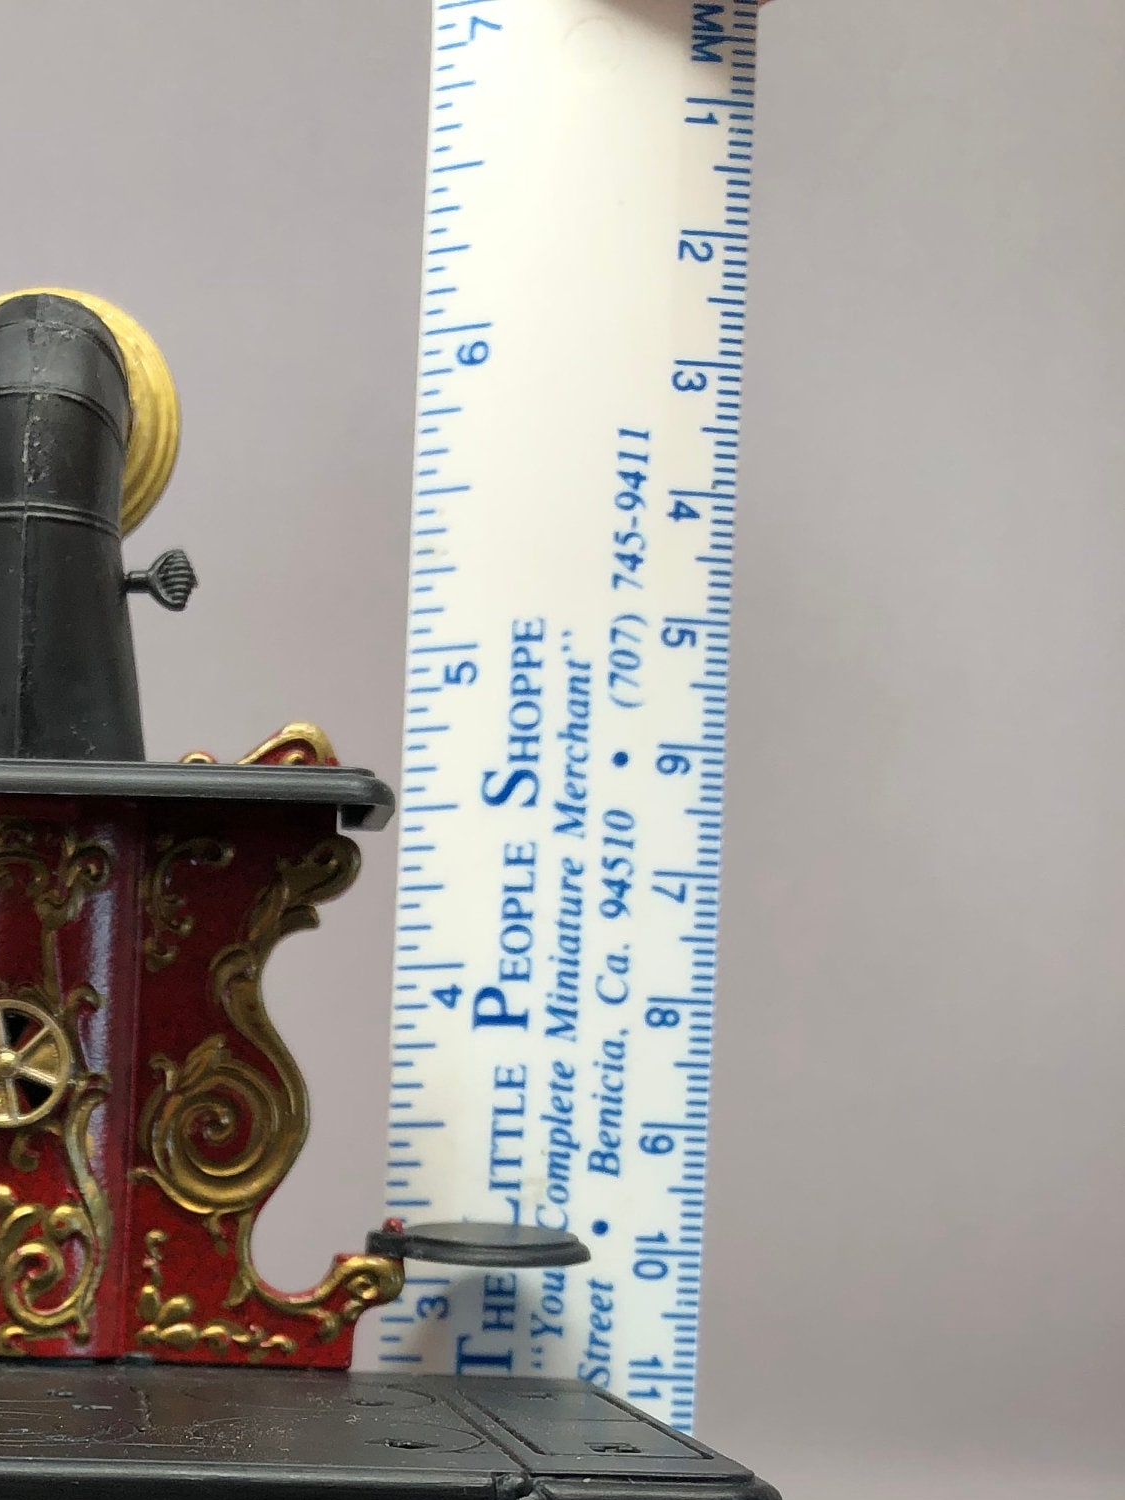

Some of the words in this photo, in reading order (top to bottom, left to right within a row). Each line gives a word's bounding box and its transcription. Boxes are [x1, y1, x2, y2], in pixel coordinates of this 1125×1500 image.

[468, 15, 503, 41] 7
[690, 3, 724, 63] MM
[683, 112, 719, 125] 1
[678, 240, 715, 263] 2
[455, 339, 491, 367] 6
[671, 369, 708, 393] 3
[611, 427, 652, 590] 745-9411
[667, 499, 701, 522] 4
[607, 612, 650, 709] (707)
[660, 626, 698, 650] 5
[443, 660, 479, 686] 5
[480, 615, 545, 810] SHOPPE
[655, 754, 693, 777] 6
[598, 807, 637, 920] 94510
[651, 881, 688, 904] 7
[470, 840, 538, 1031] PEOPLE
[542, 855, 587, 1041] Miniature
[430, 983, 465, 1010] 4
[594, 942, 632, 1007] Ca.
[644, 1007, 682, 1031] 8
[586, 1028, 631, 1178] Benicia,
[535, 1058, 582, 1232] Complete
[638, 1131, 677, 1157] 9
[632, 1231, 669, 1281] 10
[416, 1295, 449, 1320] 3
[455, 1271, 517, 1377] THE
[529, 1265, 567, 1370] “You
[577, 1277, 615, 1389] Street
[627, 1354, 664, 1400] 11
